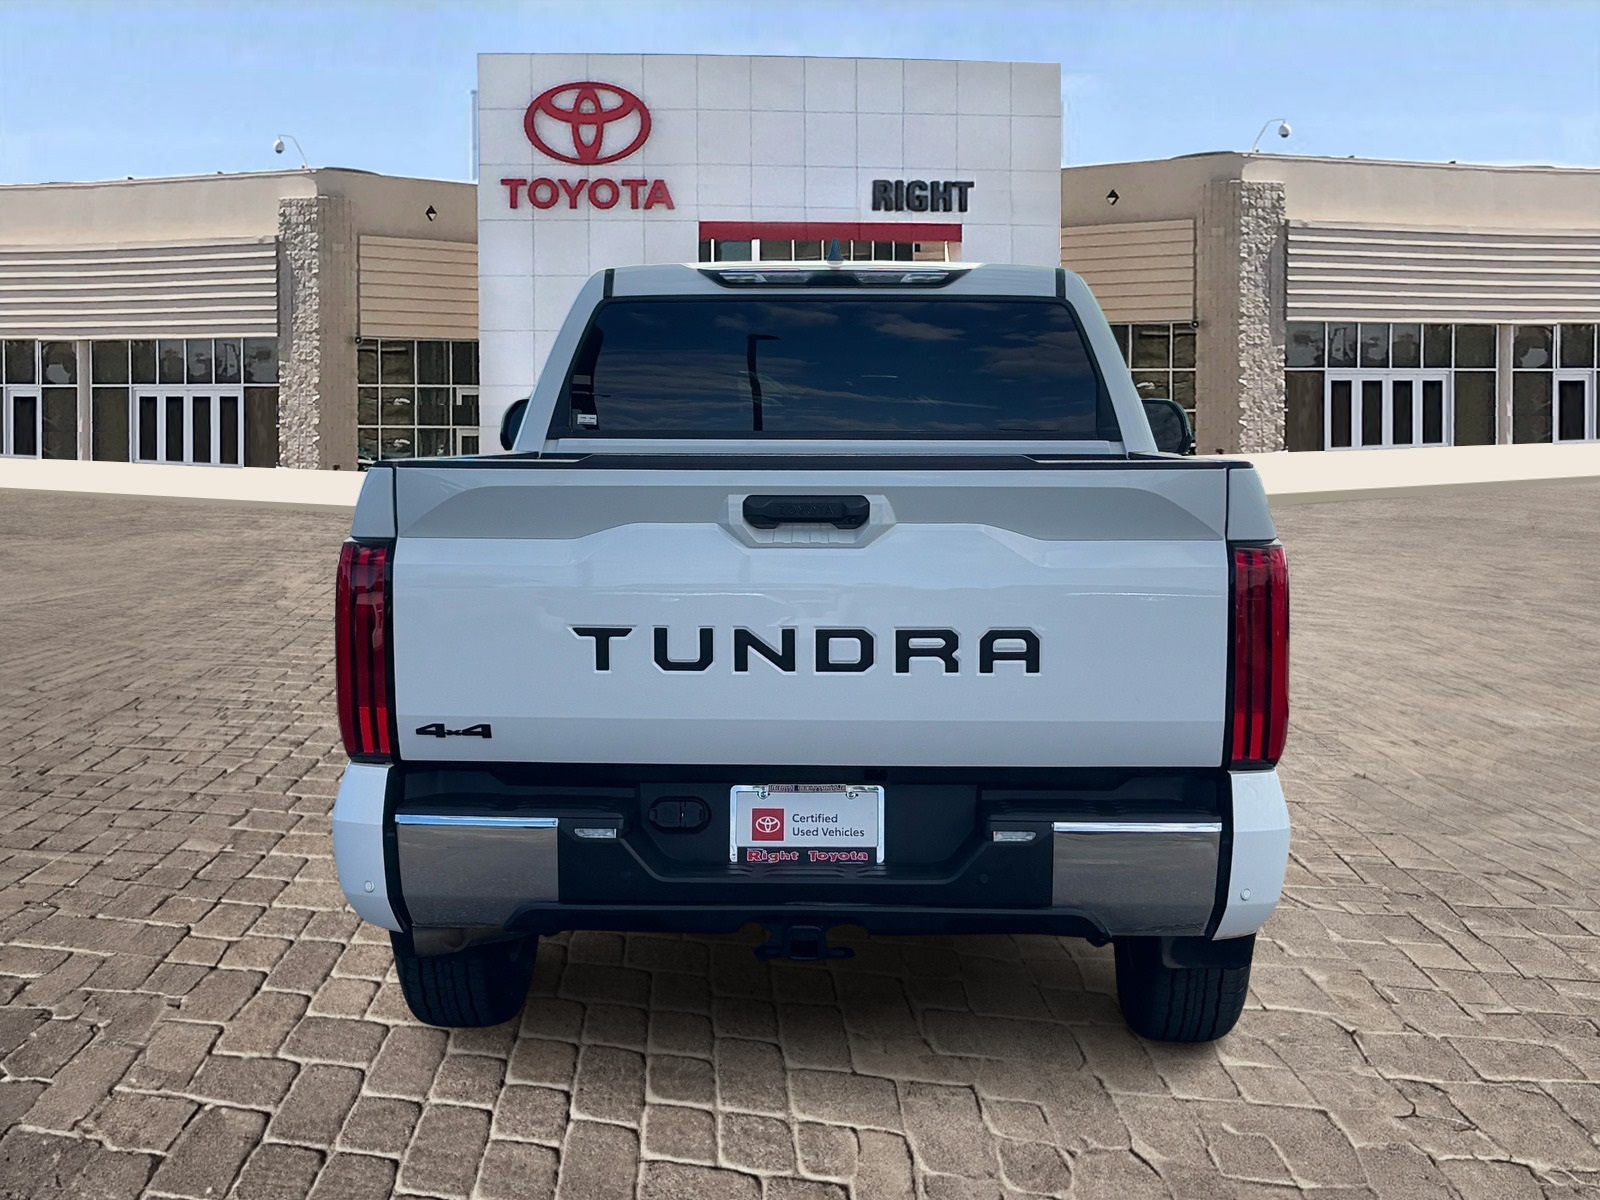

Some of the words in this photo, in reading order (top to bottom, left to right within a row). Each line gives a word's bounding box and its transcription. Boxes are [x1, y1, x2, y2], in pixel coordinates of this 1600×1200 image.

[500, 178, 675, 210] TOYOTA
[871, 179, 975, 213] RIGHT
[776, 504, 834, 516] OYOA
[571, 626, 1042, 674] TUNDRA
[792, 813, 838, 824] Certified
[792, 827, 819, 837] Used
[821, 827, 865, 838] Vehicles
[746, 850, 800, 863] Right
[807, 850, 869, 862] Toyota
